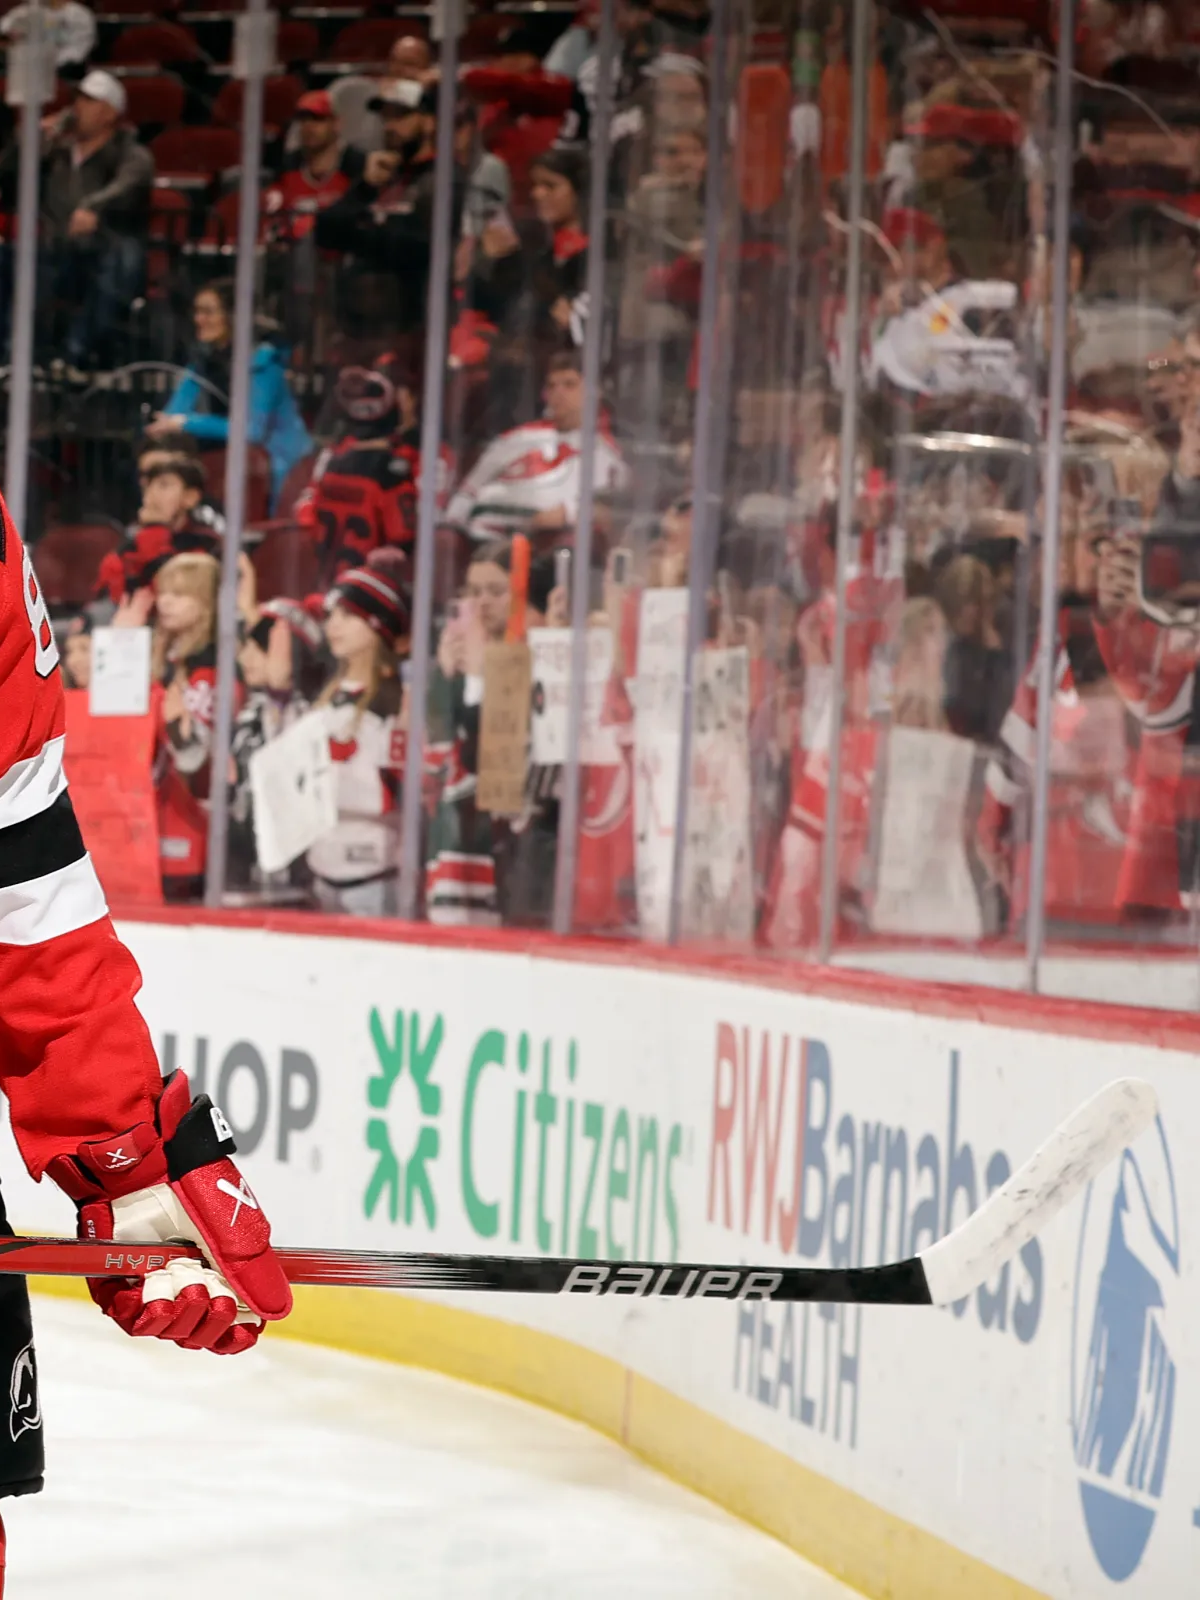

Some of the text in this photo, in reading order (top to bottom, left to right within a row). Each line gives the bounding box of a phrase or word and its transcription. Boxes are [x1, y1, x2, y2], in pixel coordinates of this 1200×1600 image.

[461, 1028, 684, 1262] Citizens
[104, 1253, 186, 1270] HYP
[558, 1265, 783, 1301] BAUER
[733, 1258, 862, 1450] HEALTH
